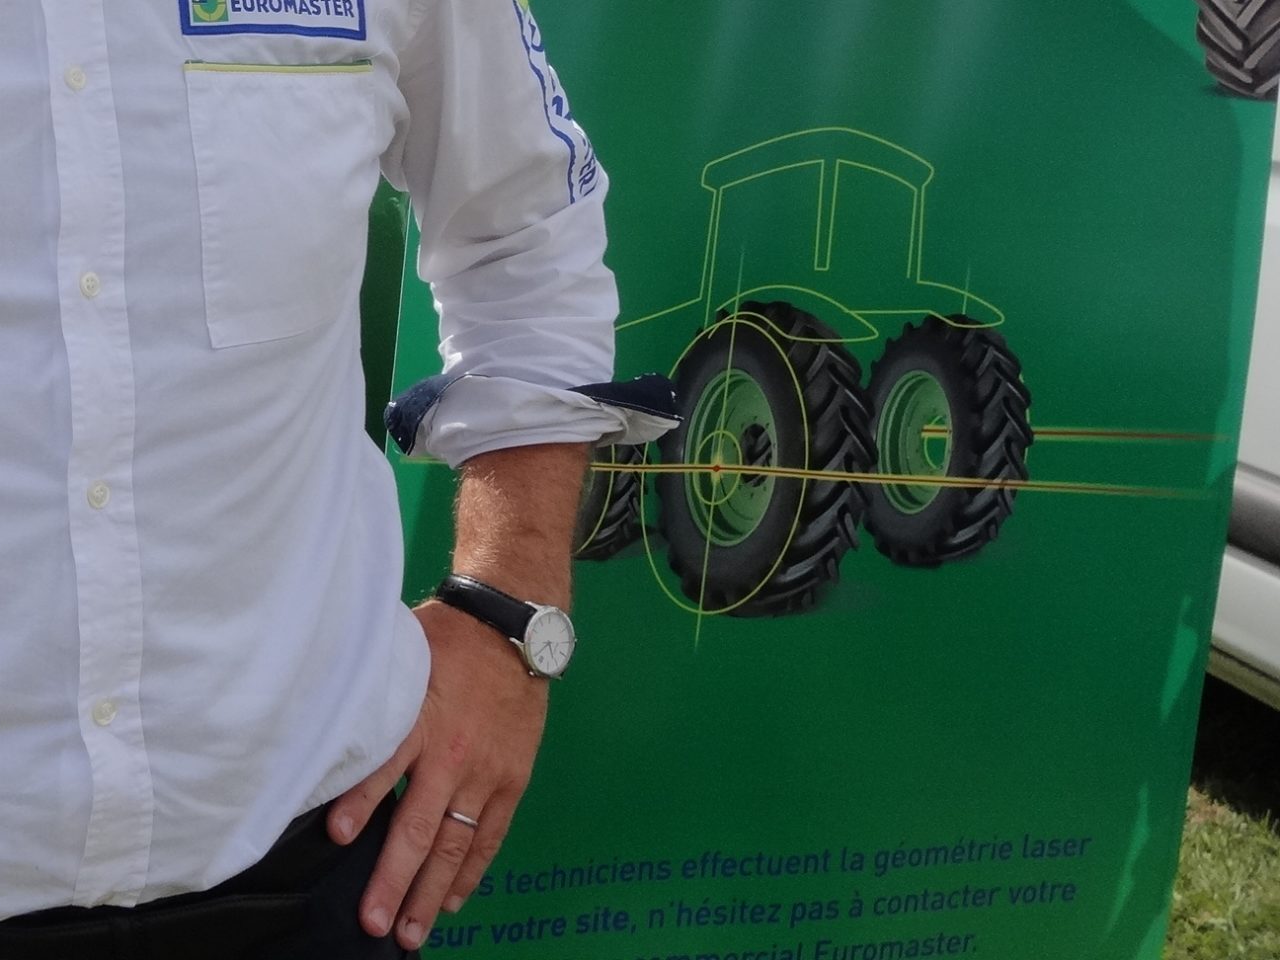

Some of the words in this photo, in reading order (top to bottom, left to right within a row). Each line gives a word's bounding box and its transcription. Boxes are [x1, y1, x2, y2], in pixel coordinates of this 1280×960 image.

[505, 857, 672, 894] techniciens
[681, 850, 832, 880] effectuent
[840, 846, 866, 874] la
[874, 835, 1013, 878] géométrie
[1022, 833, 1093, 859] laser
[428, 923, 481, 949] sur
[490, 915, 568, 945] votre
[575, 906, 637, 935] site,
[789, 897, 839, 929] pas
[848, 890, 864, 919] à
[872, 884, 1001, 917] contacter
[1008, 880, 1078, 906] votre
